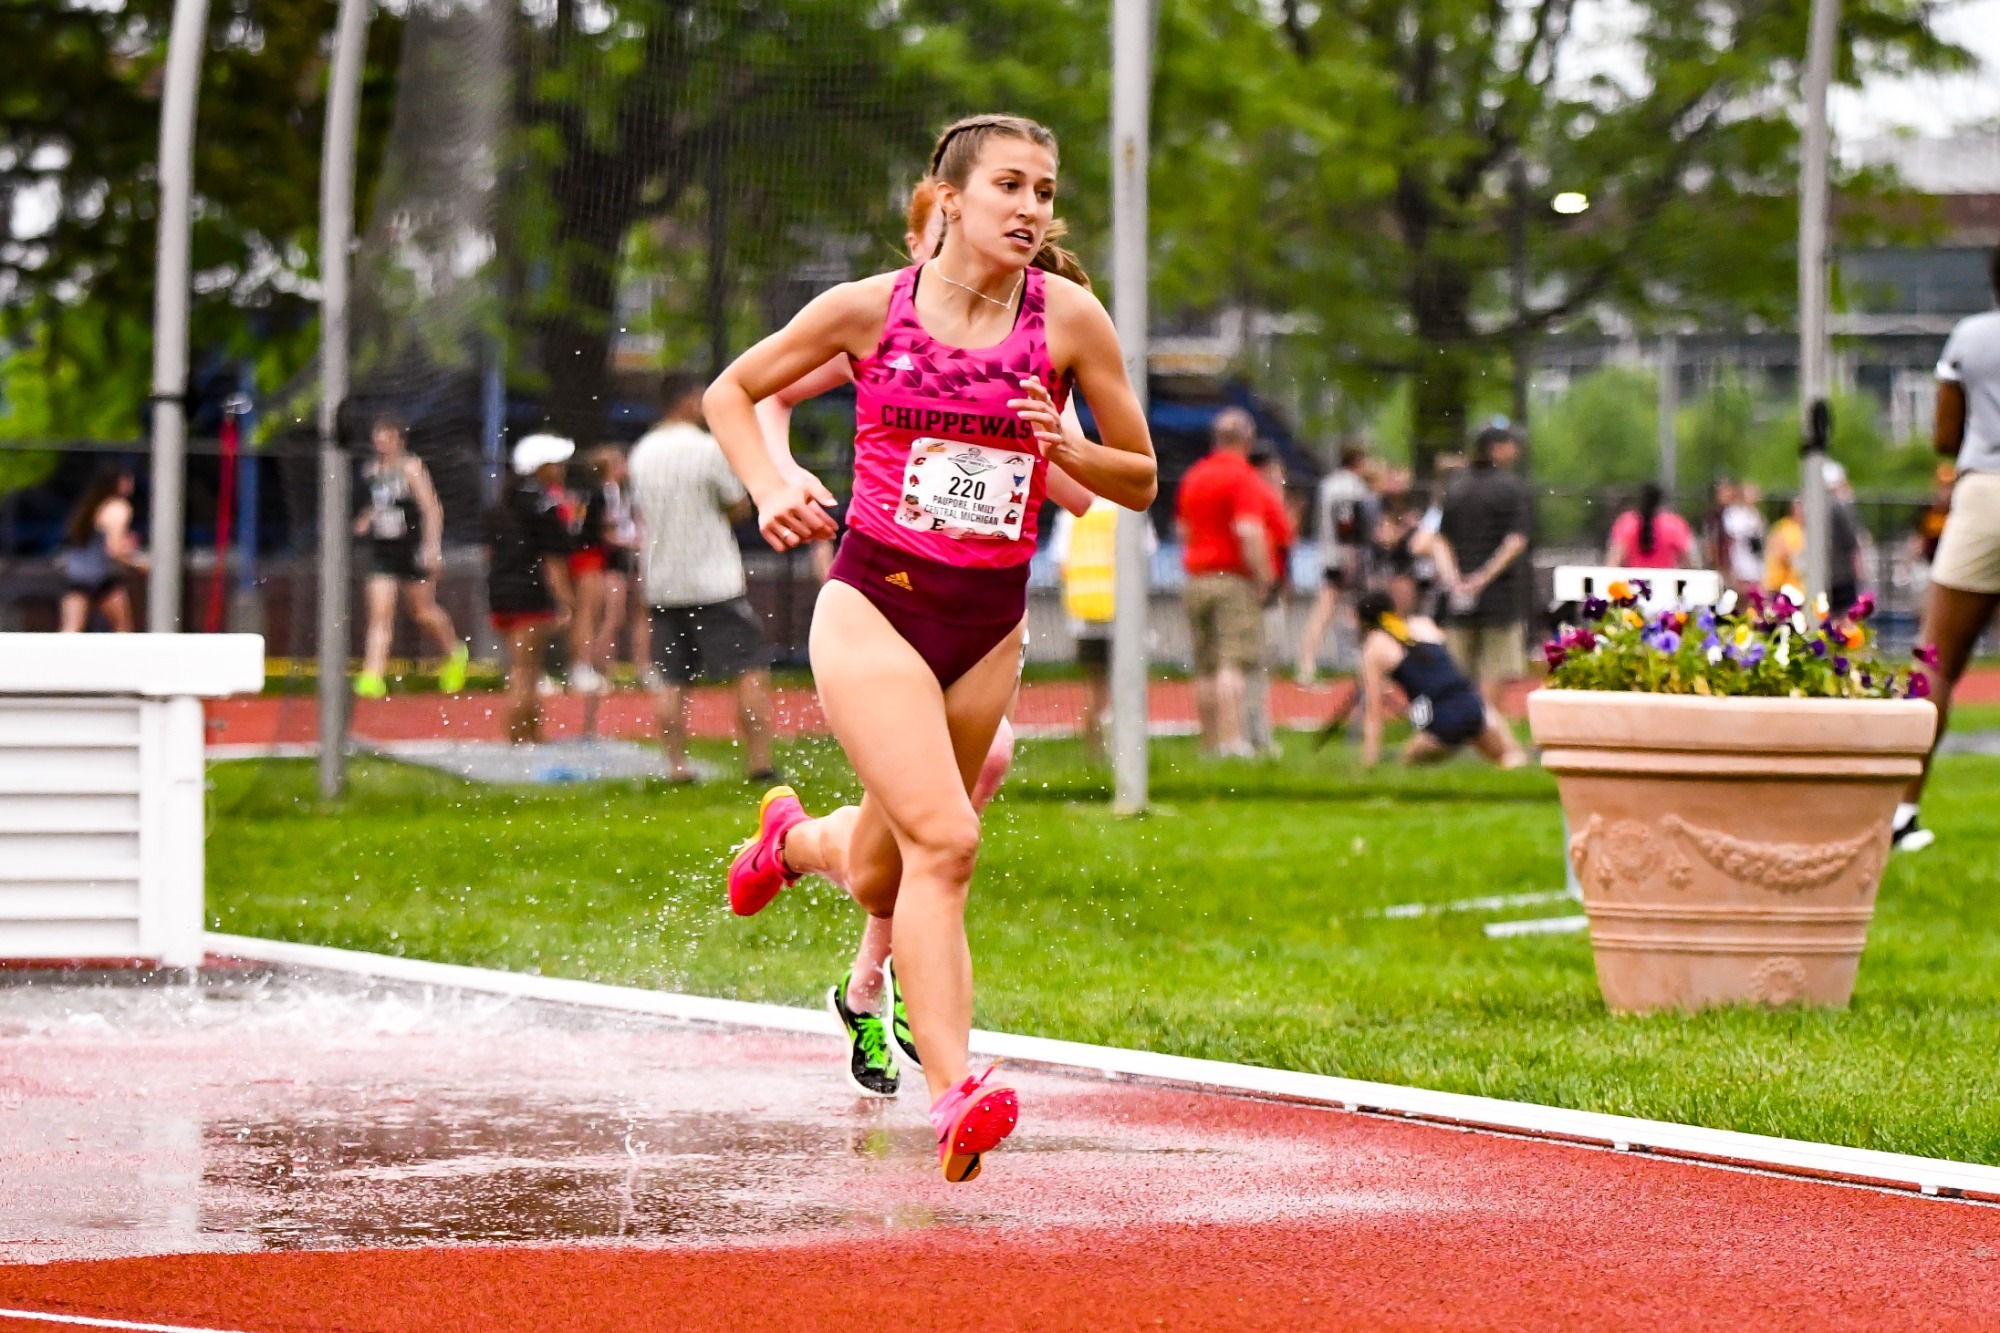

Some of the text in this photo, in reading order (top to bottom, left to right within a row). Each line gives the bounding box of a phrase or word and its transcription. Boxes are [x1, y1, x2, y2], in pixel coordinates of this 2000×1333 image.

[881, 404, 1032, 439] CHIPPEWAS
[948, 476, 986, 501] 220
[923, 504, 958, 519] CENTRAL
[960, 511, 1000, 526] MICHIGAN
[972, 502, 996, 515] EMILY
[930, 517, 946, 531] E
